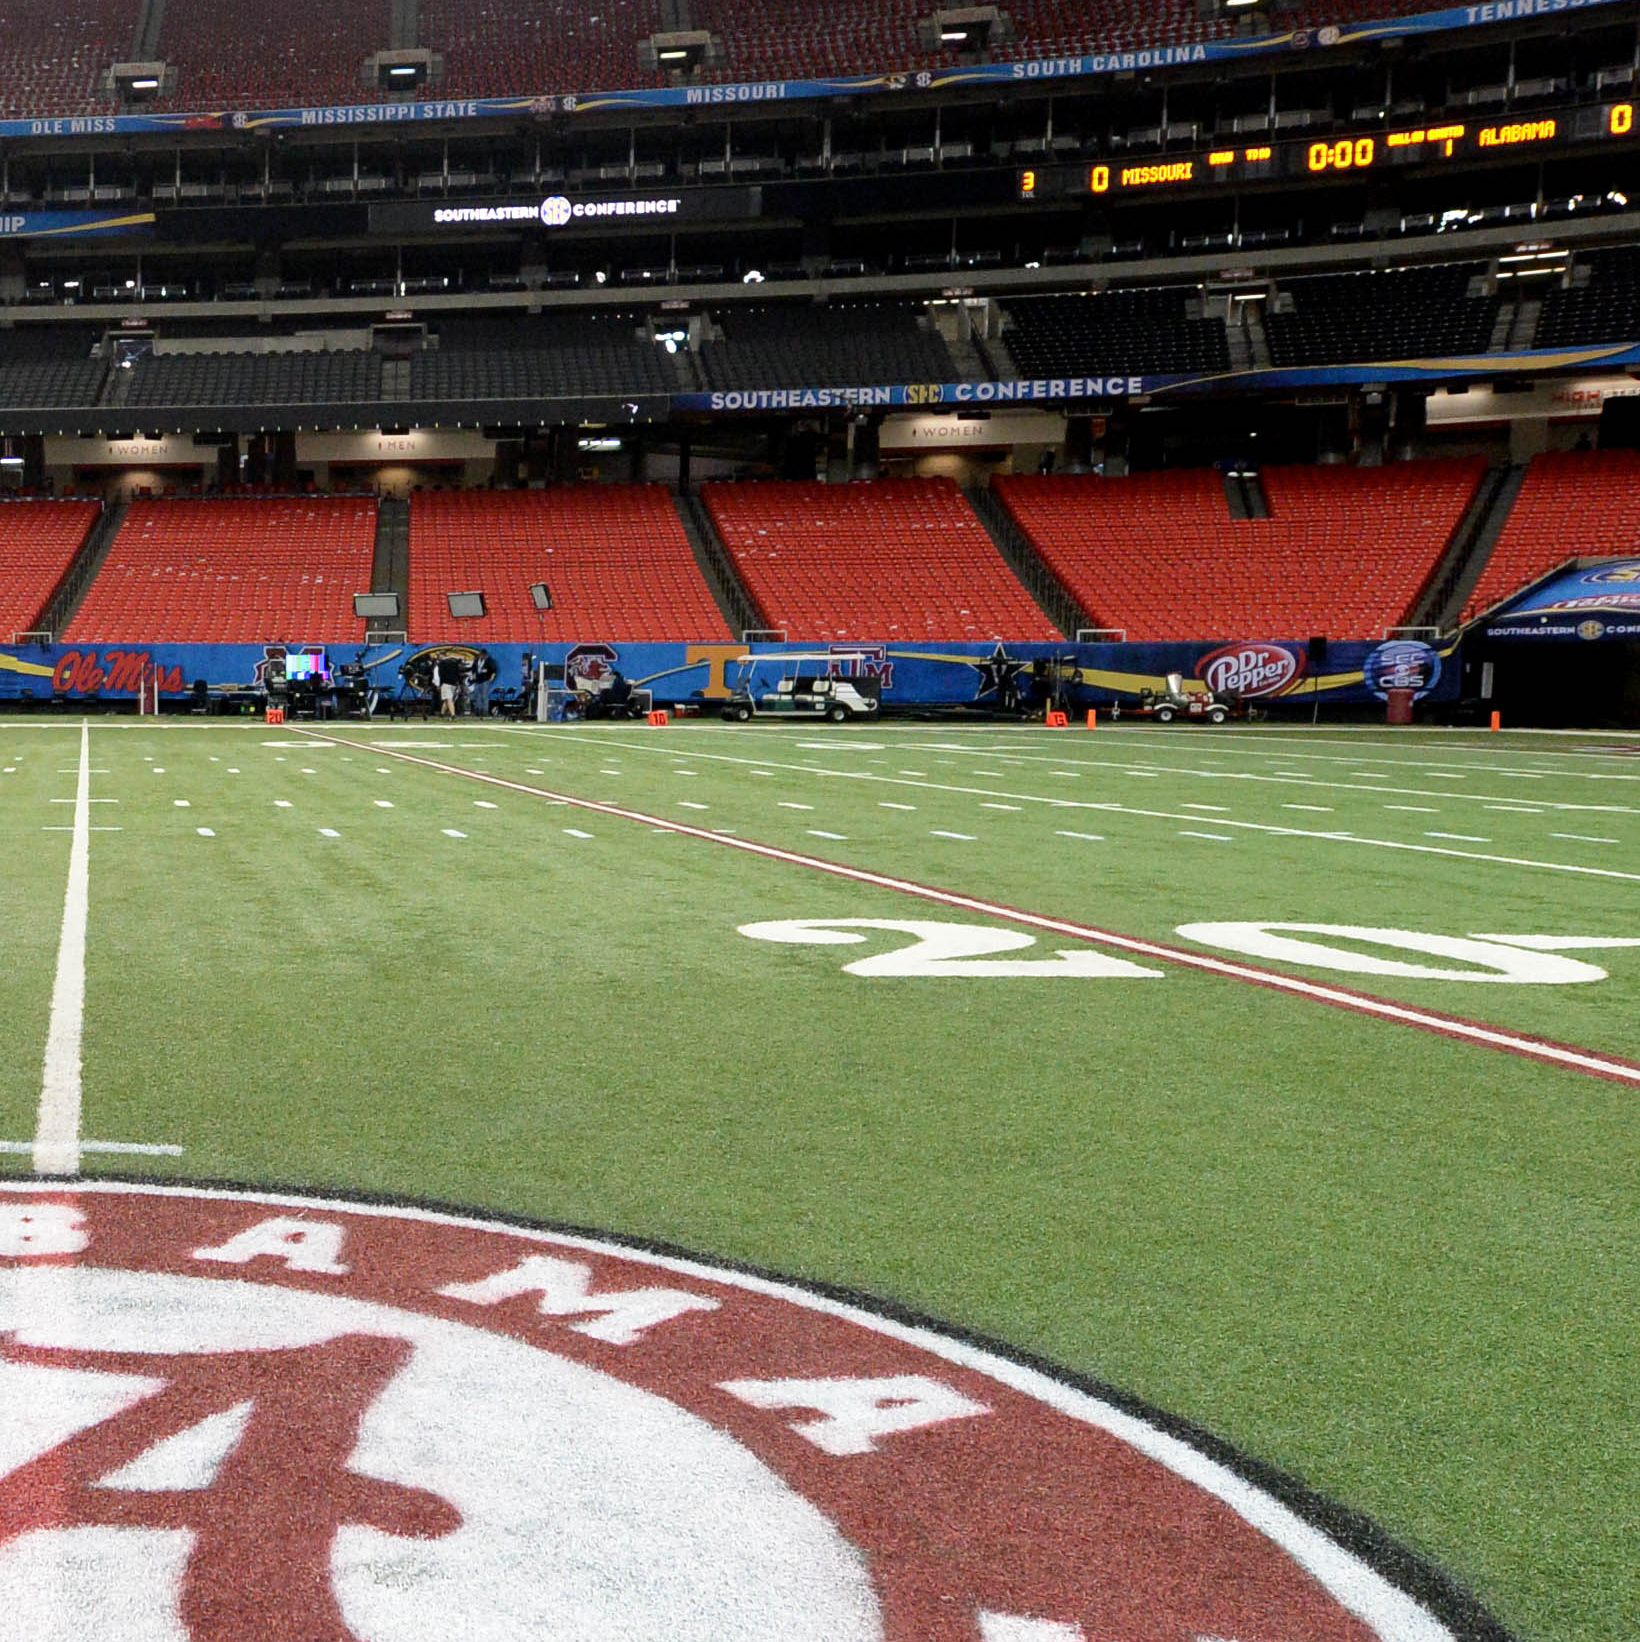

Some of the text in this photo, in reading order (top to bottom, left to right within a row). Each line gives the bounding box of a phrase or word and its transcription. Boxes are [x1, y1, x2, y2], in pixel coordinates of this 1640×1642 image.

[1013, 44, 1207, 79] SOUTH CAROLINA
[687, 83, 786, 104] MISSOURI
[301, 102, 477, 125] MISSISSIPPI STATE
[1610, 104, 1633, 134] 0
[32, 118, 117, 135] OLE MISS
[1479, 120, 1555, 147] ALABAMA
[1309, 138, 1374, 171] 0:00
[1022, 172, 1035, 191] 3
[1091, 166, 1109, 193] 0
[1122, 163, 1193, 186] MISSOURI
[434, 205, 539, 223] SOUTHEASTERN
[573, 200, 677, 217] CONFERENCE
[711, 386, 891, 411] SOUTHEASTERN
[955, 376, 1143, 403] CONFERENCE
[923, 424, 984, 438] WOMEN
[119, 444, 168, 455] WOMEN
[387, 440, 416, 451] MEN
[1487, 625, 1576, 637] SOUTHEASTERN
[1240, 650, 1270, 672] Dr
[1380, 652, 1425, 665] SEC
[51, 650, 186, 692] Ole Miss
[1217, 655, 1290, 692] Pepper
[1379, 676, 1424, 688] CBS
